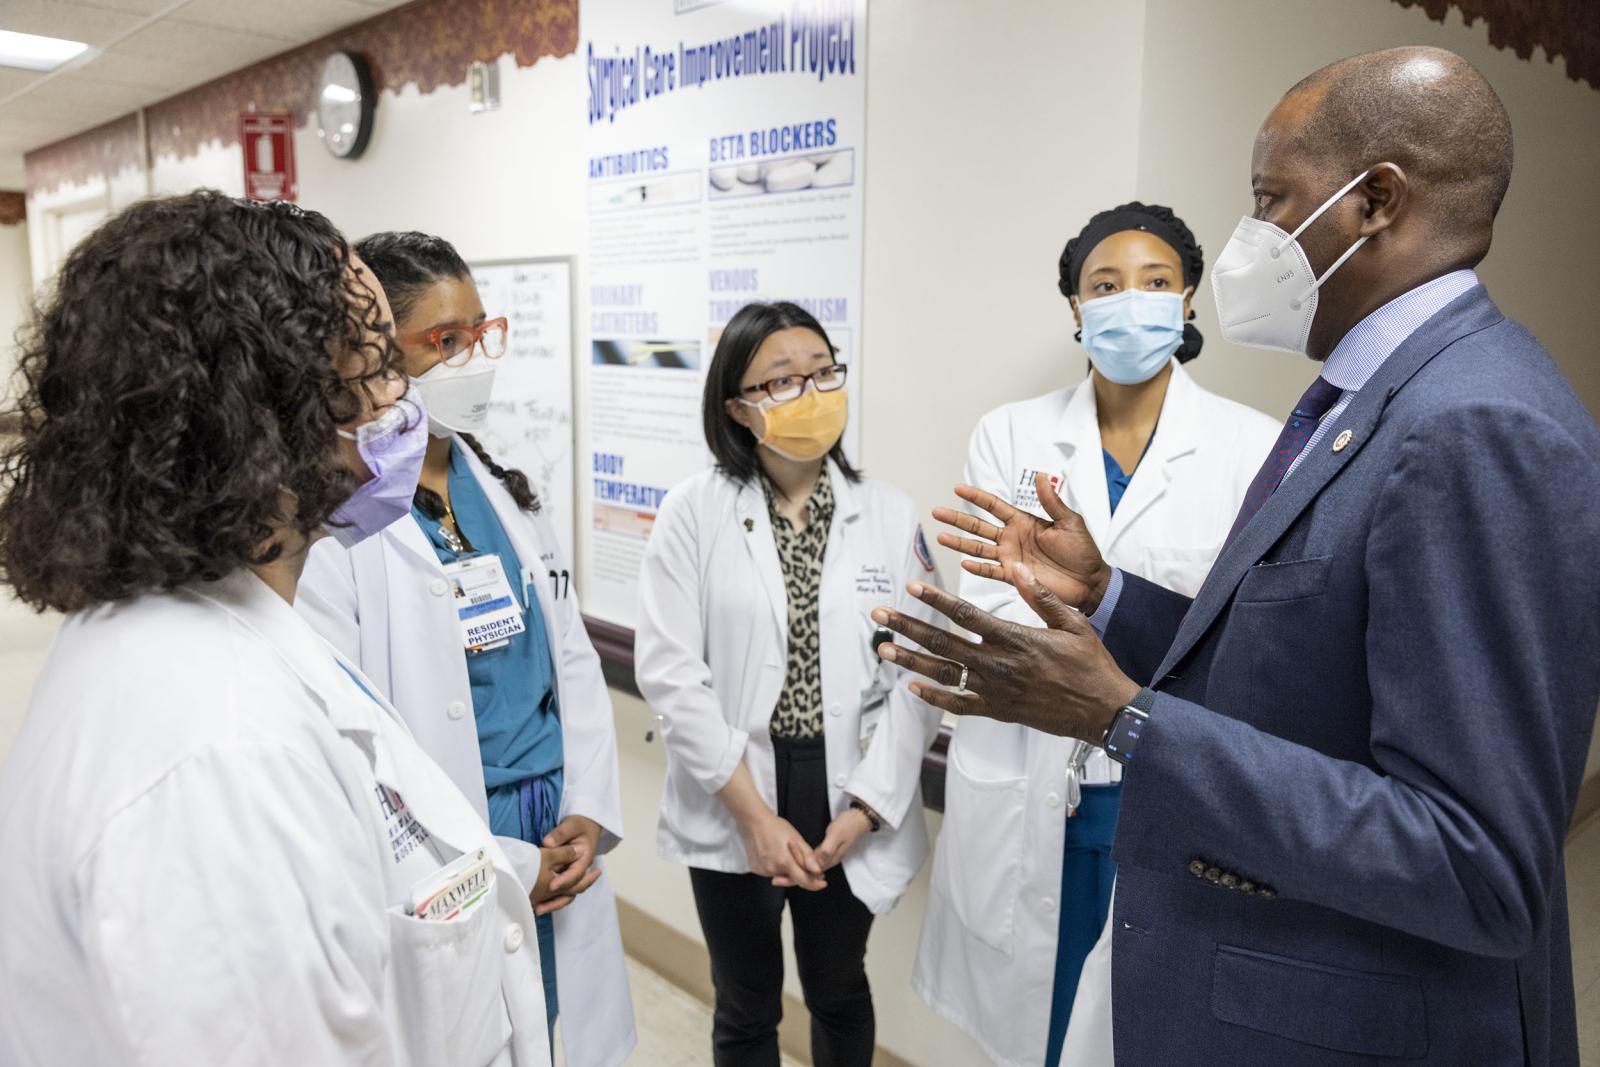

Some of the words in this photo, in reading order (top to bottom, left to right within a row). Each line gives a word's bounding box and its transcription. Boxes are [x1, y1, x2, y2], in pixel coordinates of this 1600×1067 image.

[588, 41, 639, 125] Surgical
[644, 45, 675, 99] Care
[680, 17, 786, 89] Improvement
[790, 4, 855, 83] Project
[710, 134, 744, 162] BETA
[751, 118, 837, 157] BLOCKERS
[588, 146, 668, 178] ANTIBIOTICS
[594, 452, 624, 475] BODY
[594, 478, 668, 509] TEMPERATU
[467, 616, 515, 637] RESIDENT
[469, 624, 521, 646] PHYSICIAN
